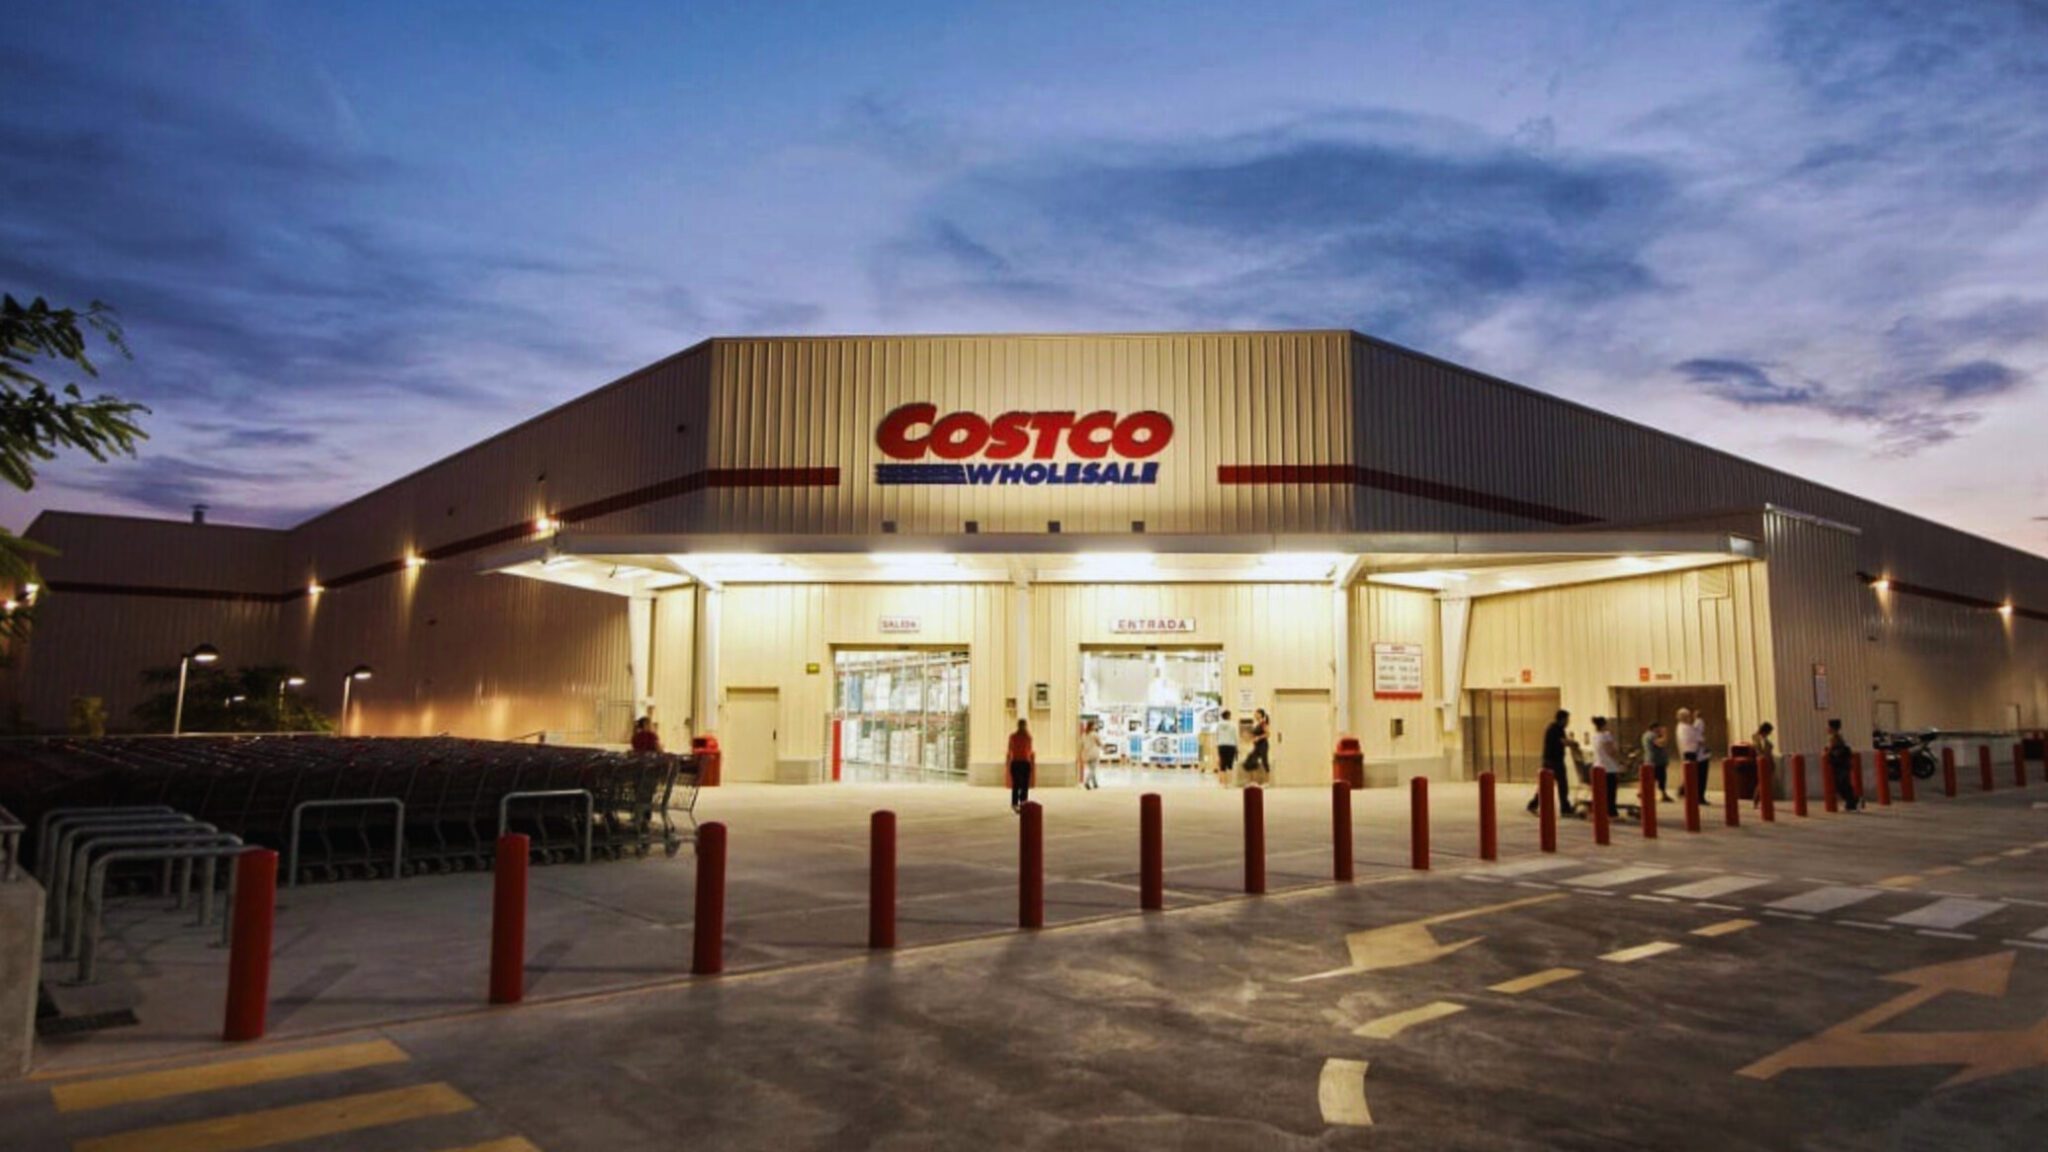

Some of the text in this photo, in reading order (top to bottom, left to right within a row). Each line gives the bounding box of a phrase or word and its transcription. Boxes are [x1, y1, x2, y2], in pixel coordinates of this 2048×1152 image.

[876, 402, 1174, 460] COSTCO
[965, 462, 1160, 485] WHOLESALE
[1118, 618, 1187, 630] ENTRADA
